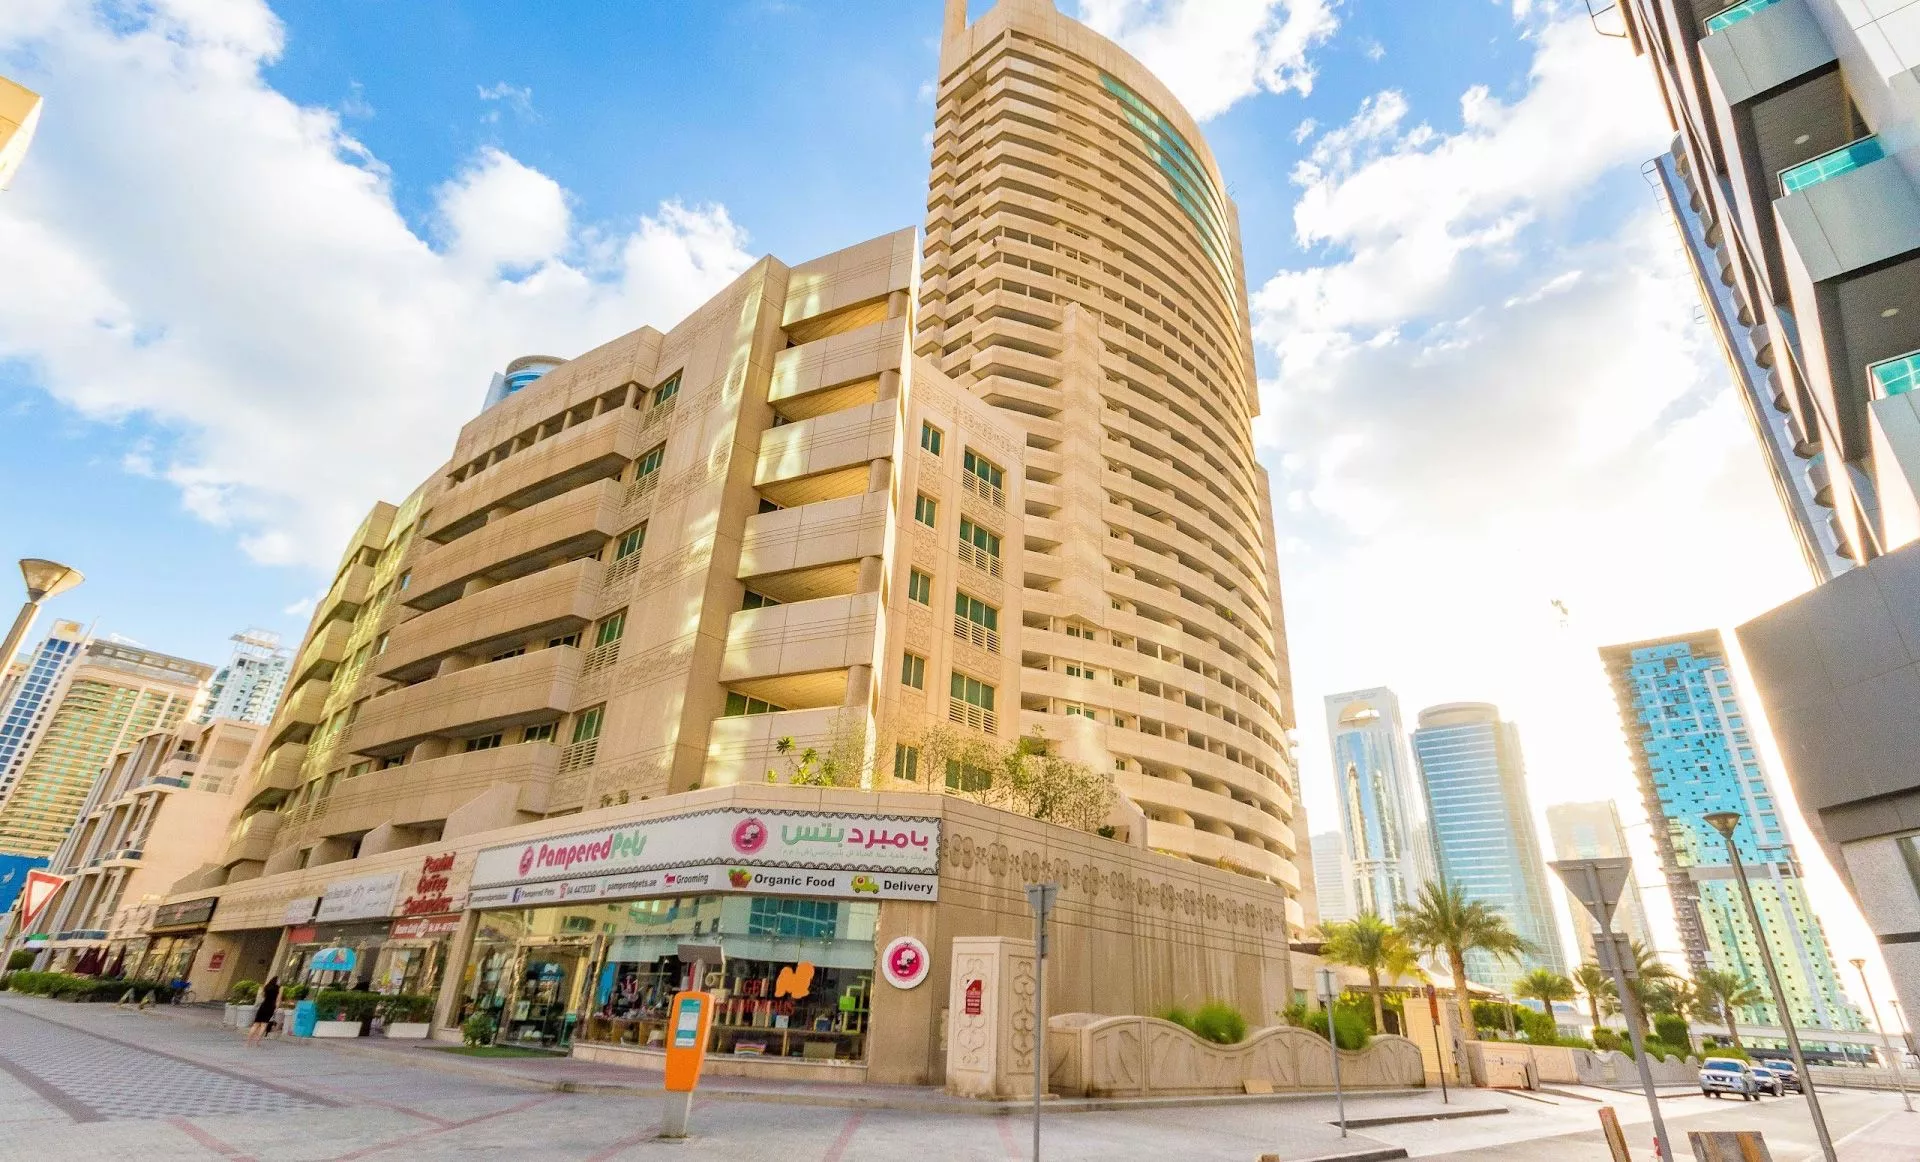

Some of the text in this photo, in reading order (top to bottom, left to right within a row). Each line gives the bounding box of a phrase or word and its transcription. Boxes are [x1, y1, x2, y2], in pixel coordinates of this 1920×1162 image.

[676, 873, 709, 885] Grooming
[754, 873, 835, 888] Organic Food
[883, 880, 934, 894] Delivery
